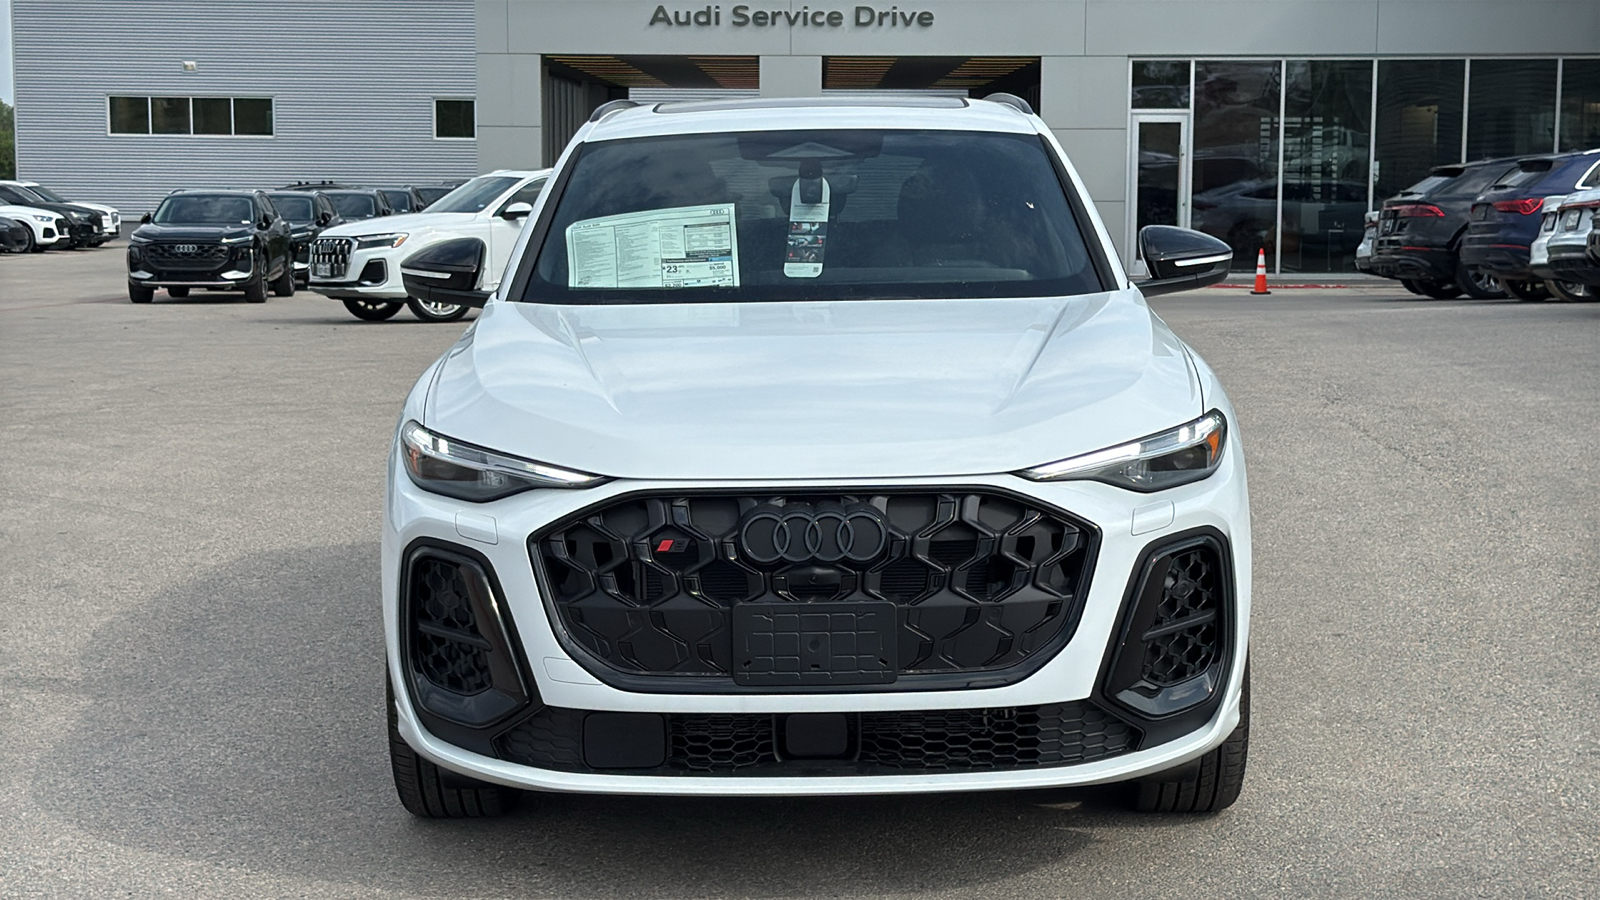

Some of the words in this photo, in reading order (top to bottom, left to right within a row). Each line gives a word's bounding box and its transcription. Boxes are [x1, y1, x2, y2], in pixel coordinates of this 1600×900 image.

[650, 5, 720, 26] Audi
[732, 5, 844, 27] Service
[855, 6, 934, 27] Drive
[666, 265, 678, 273] 23
